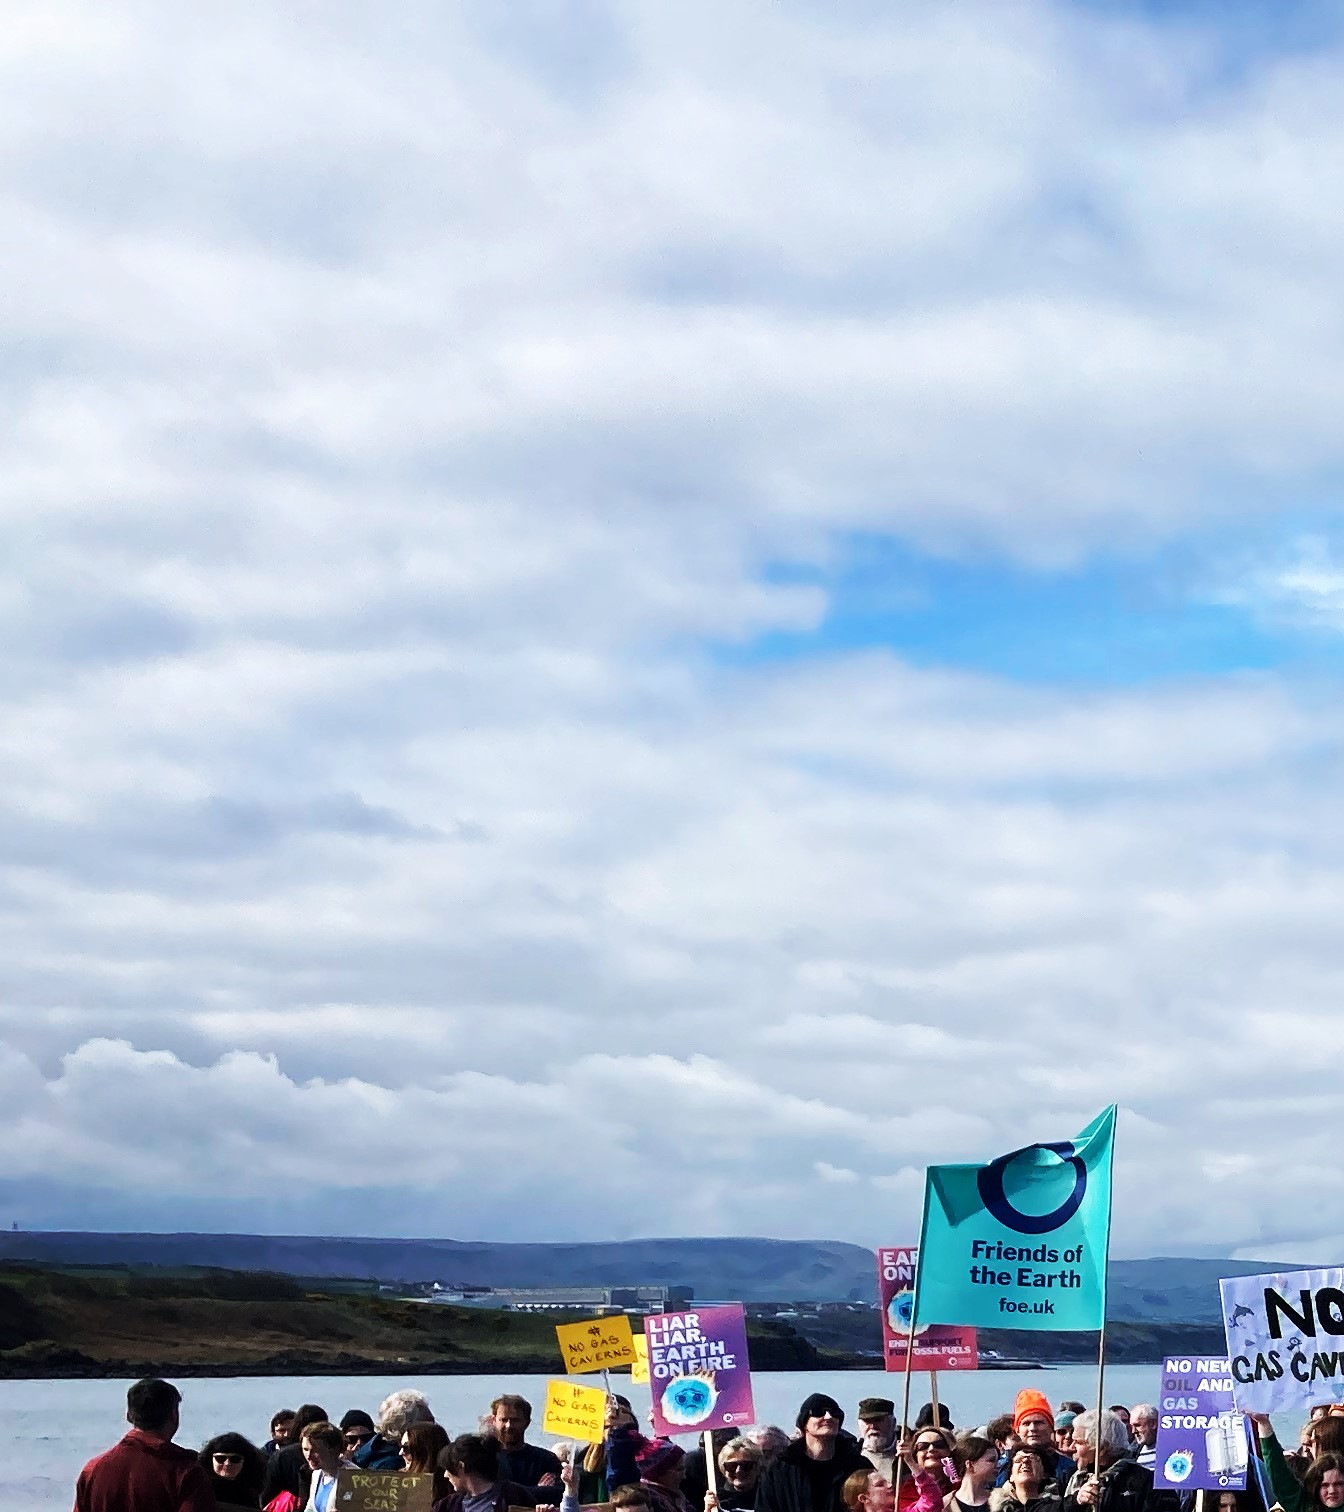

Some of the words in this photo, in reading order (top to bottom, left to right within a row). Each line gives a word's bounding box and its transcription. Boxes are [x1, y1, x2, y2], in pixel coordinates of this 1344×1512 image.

[971, 1239, 1059, 1263] Friends
[1063, 1244, 1083, 1263] of
[969, 1265, 1013, 1286] the
[1017, 1268, 1082, 1288] Earth
[999, 1297, 1055, 1315] foe.uk
[650, 1313, 700, 1333] LIAR
[568, 1341, 585, 1353] NO
[591, 1335, 619, 1349] GAS
[651, 1328, 707, 1347] LIAR,
[570, 1346, 632, 1368] CAVERNS
[652, 1341, 725, 1364] EARTH
[653, 1361, 684, 1379] ON
[688, 1354, 737, 1373] FIRE
[1166, 1360, 1192, 1373] NO
[1197, 1360, 1232, 1373] NEW
[1231, 1352, 1285, 1384] GAS
[1164, 1379, 1193, 1391] OIL
[1197, 1379, 1234, 1391] AND
[552, 1397, 566, 1408] NO
[571, 1401, 597, 1413] GAS
[1163, 1397, 1199, 1410] GAS
[546, 1411, 599, 1430] CAVERNS
[1160, 1415, 1243, 1429] STORAGE
[352, 1474, 421, 1488] PROTECT
[363, 1499, 397, 1511] SEAS
